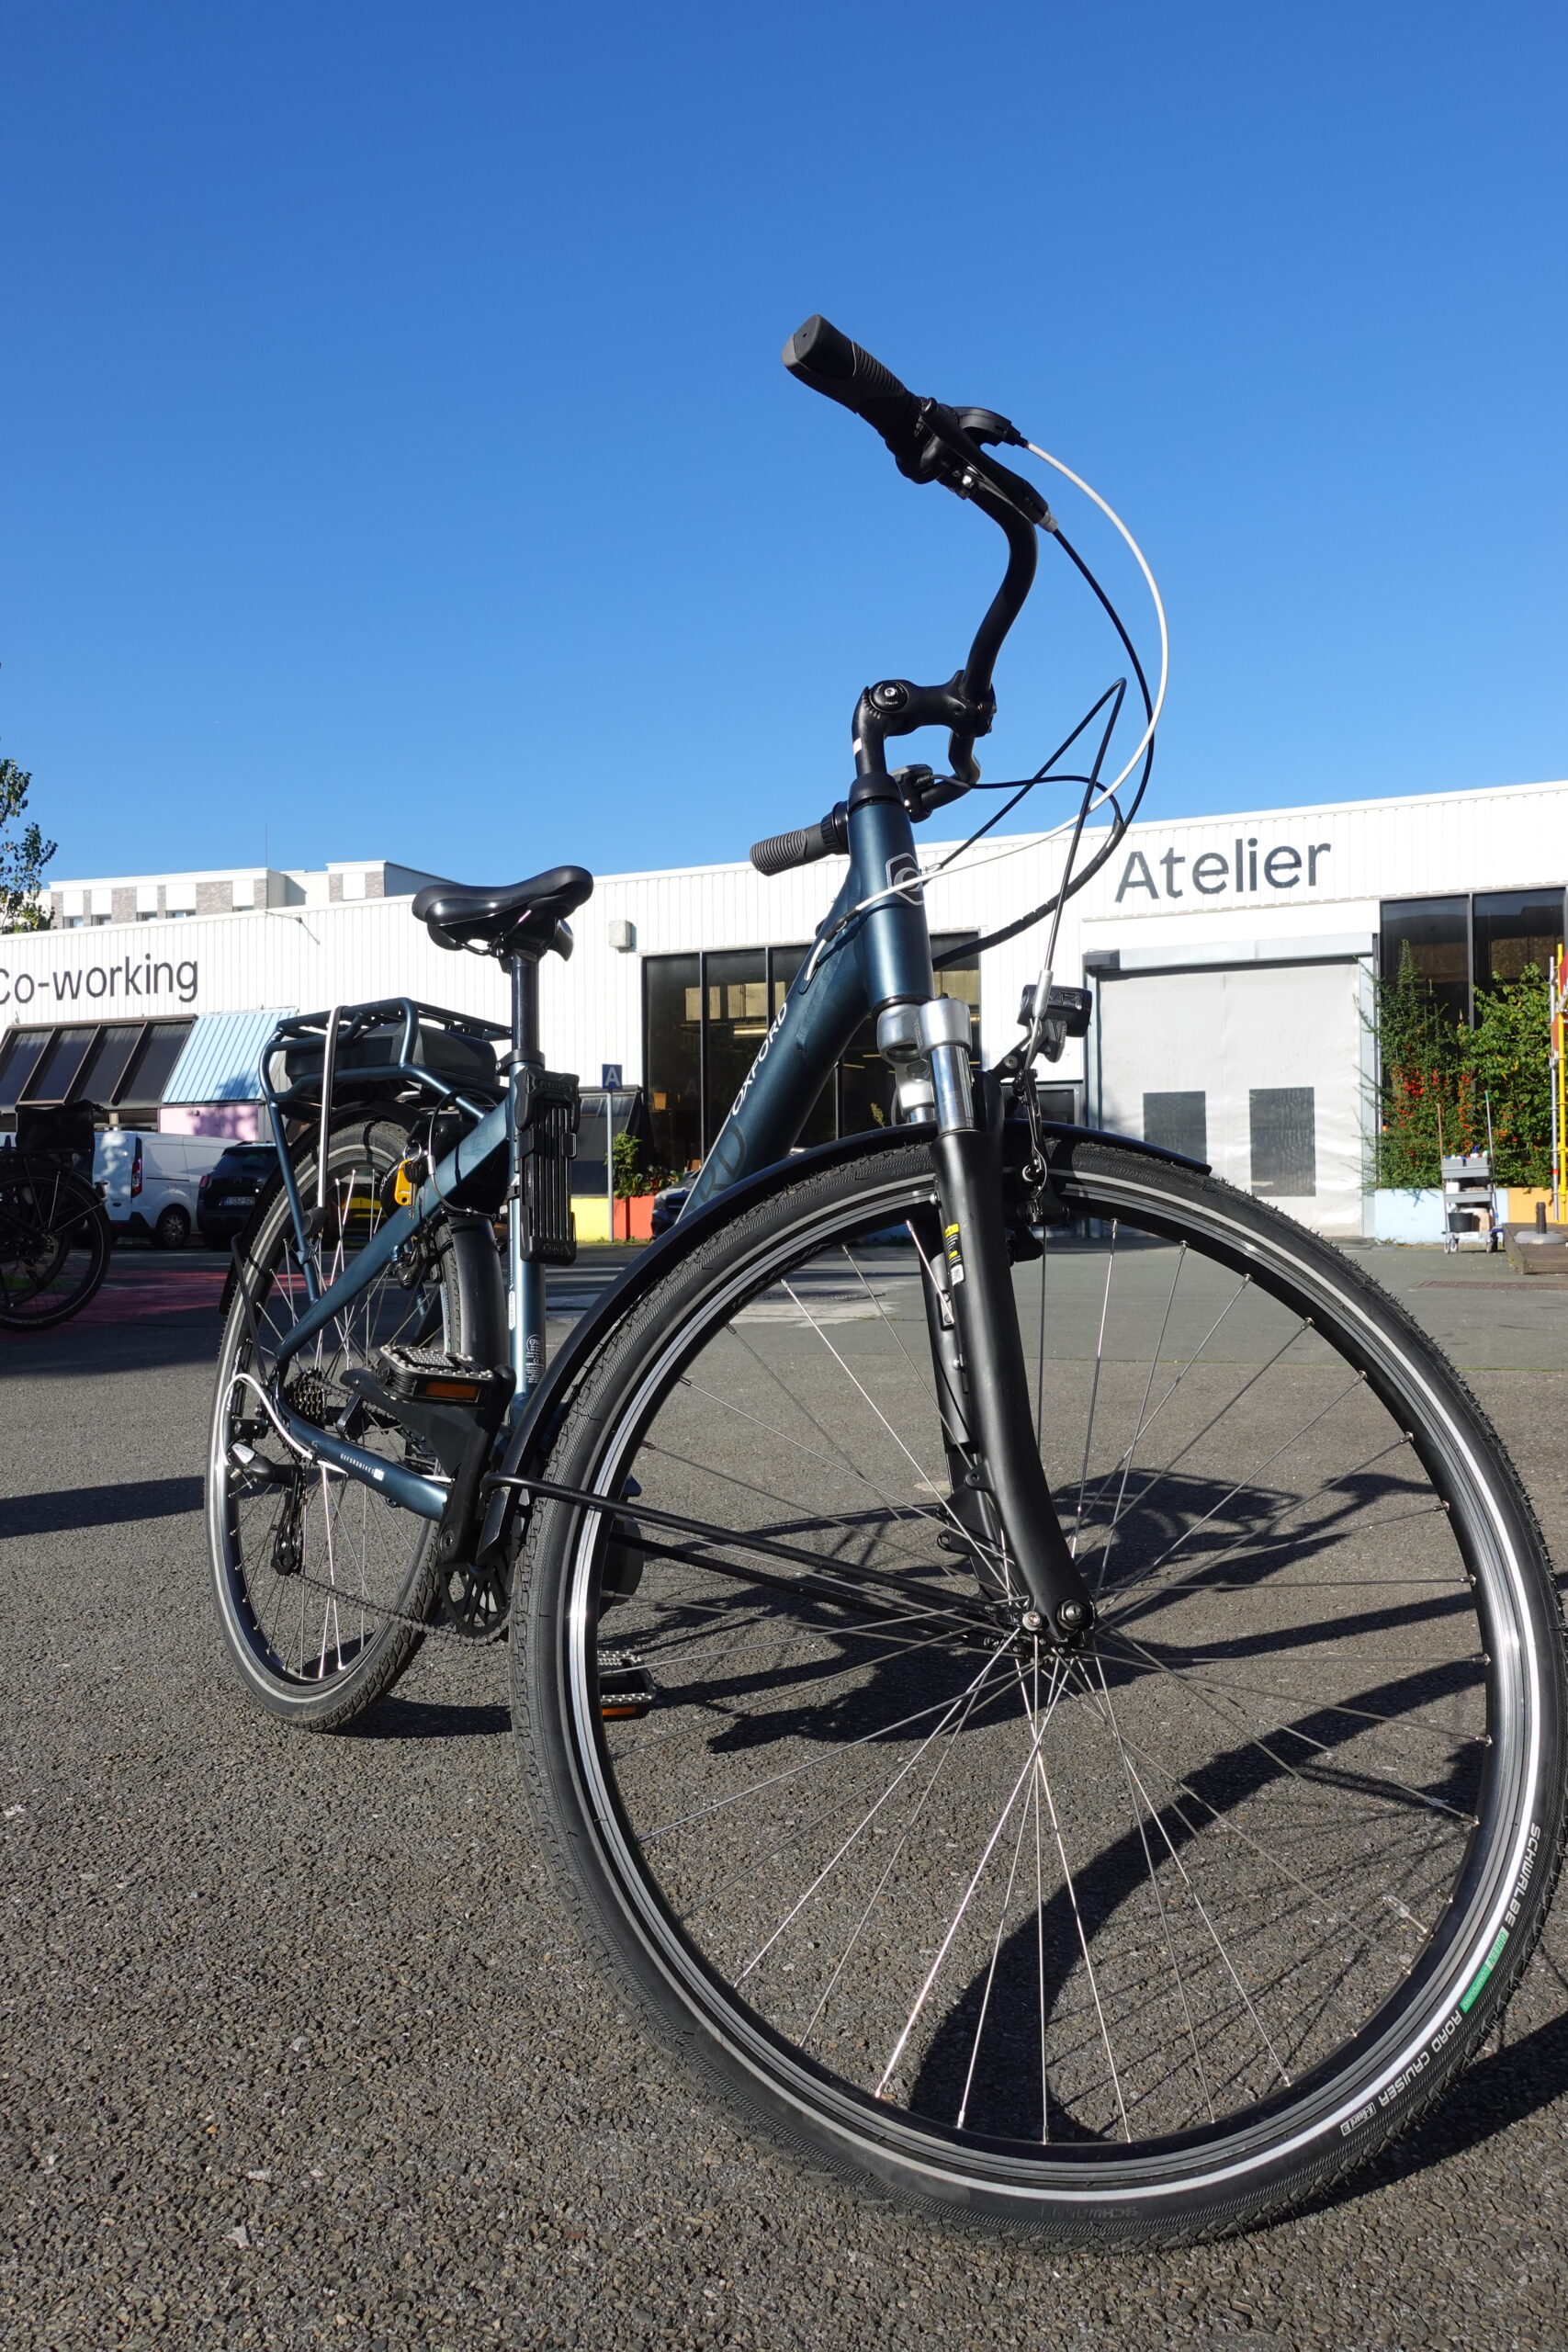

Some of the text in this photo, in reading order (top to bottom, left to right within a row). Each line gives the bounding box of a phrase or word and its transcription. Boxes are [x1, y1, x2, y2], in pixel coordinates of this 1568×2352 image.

[1114, 837, 1332, 903] Atelier
[604, 1066, 621, 1087] A
[731, 1001, 788, 1116] OXFORD
[1504, 1822, 1541, 1928] SCHWALBE
[1488, 1929, 1508, 1968] GREEN
[1461, 1966, 1492, 2010] COMPOUND
[1430, 2009, 1463, 2053] ROAD
[1378, 2051, 1431, 2108] CRUISER
